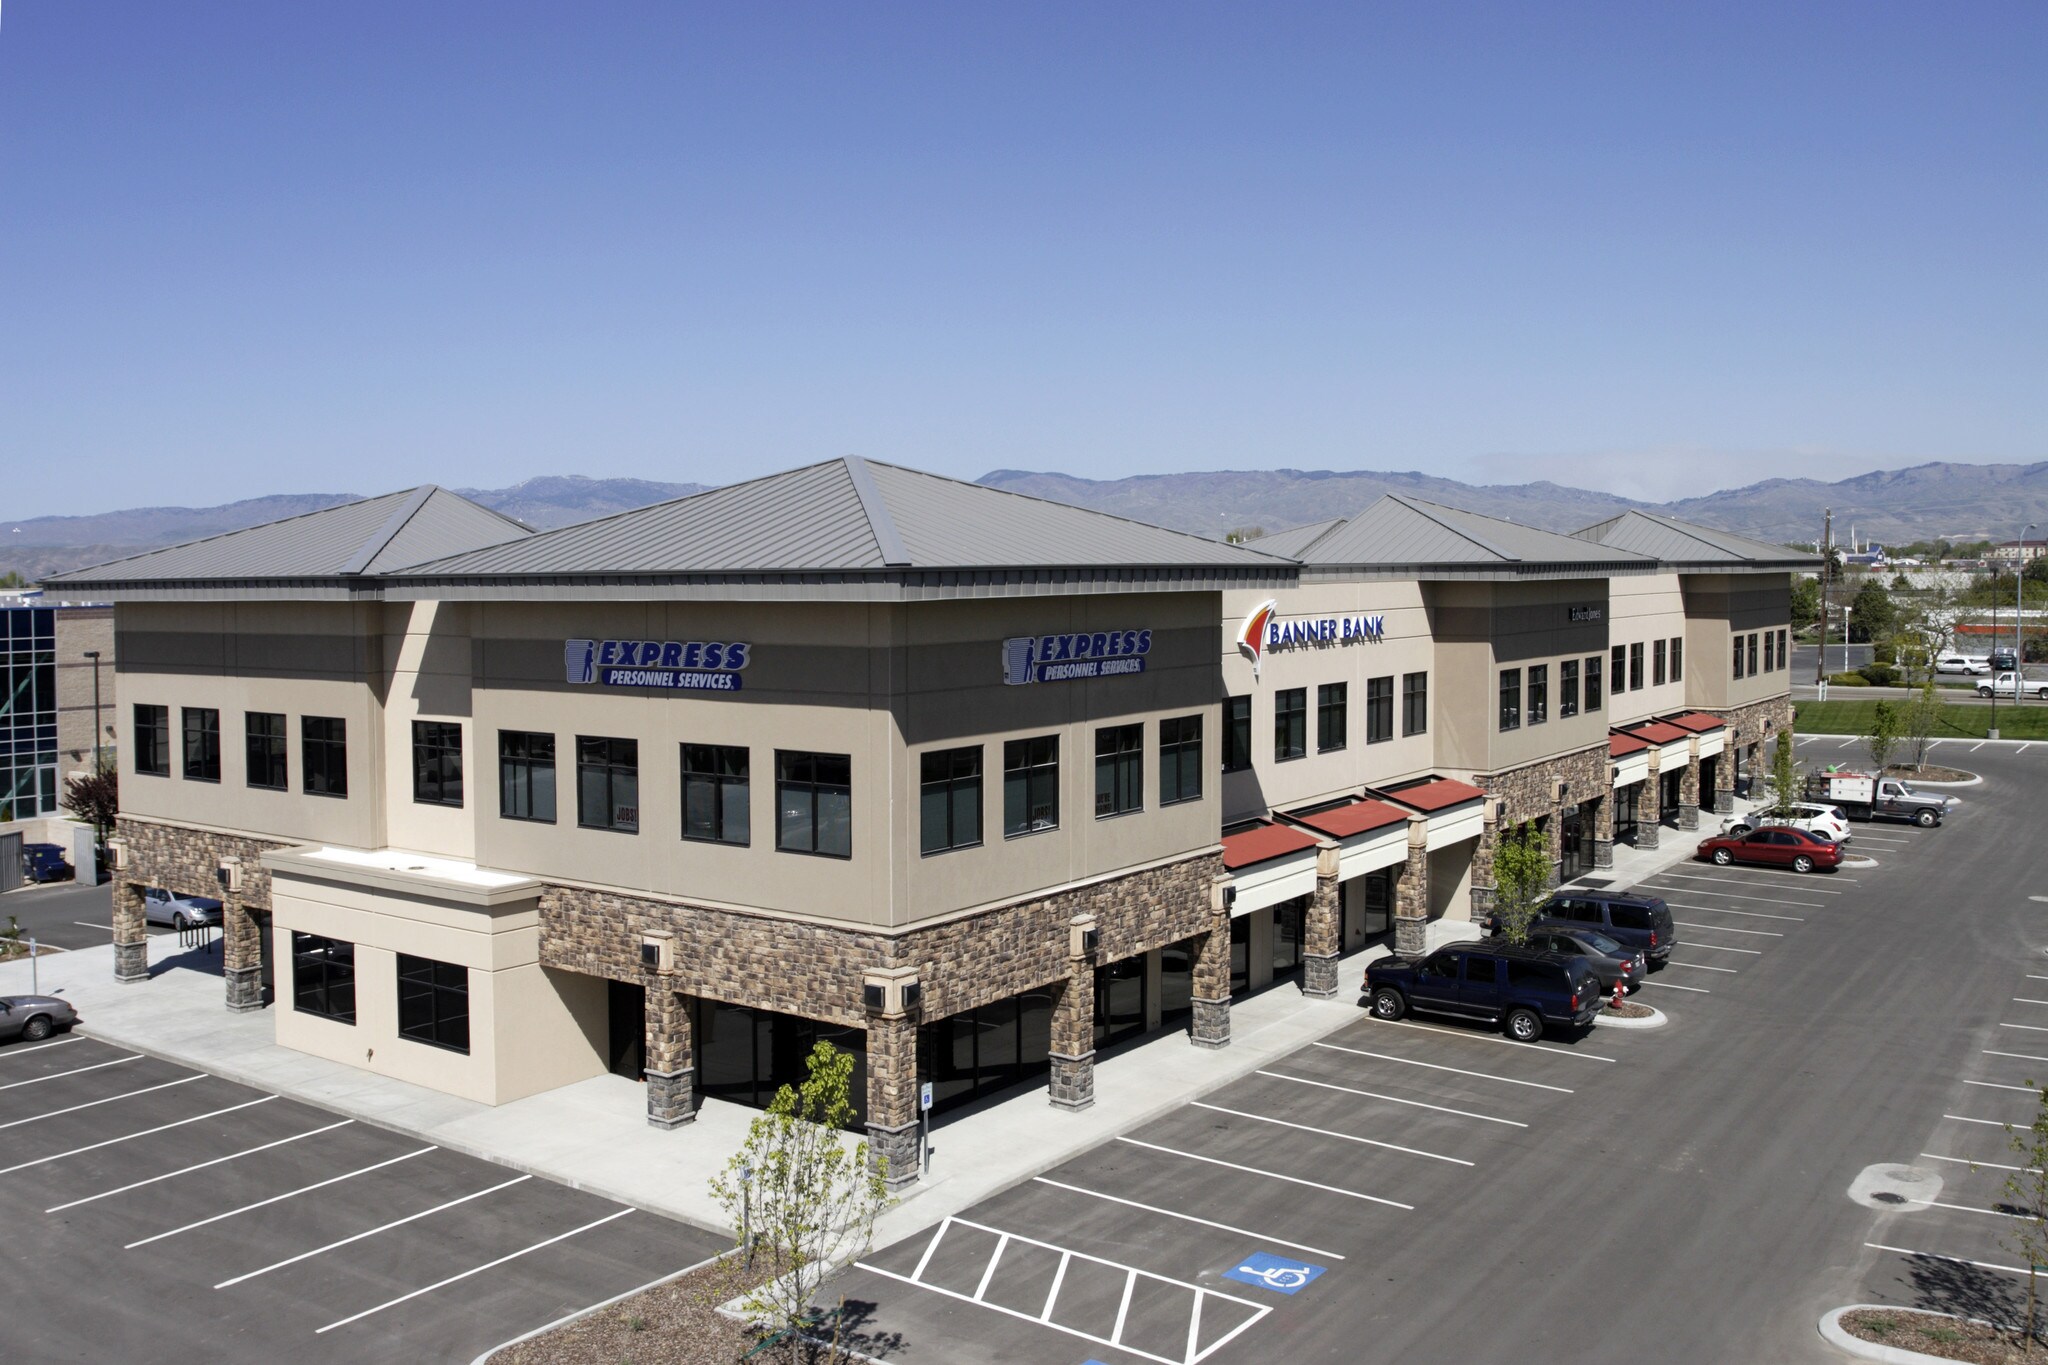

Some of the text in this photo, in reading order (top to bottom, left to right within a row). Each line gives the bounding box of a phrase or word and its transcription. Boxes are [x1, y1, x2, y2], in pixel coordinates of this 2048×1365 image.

[1268, 615, 1384, 645] BANNER BANK
[598, 641, 750, 670] EXPRESS
[1038, 630, 1152, 662] EXPRESS
[609, 670, 674, 687] PERSONNEL
[1044, 658, 1141, 681] PERSONNEL SERVICES
[617, 806, 637, 823] JOBS!
